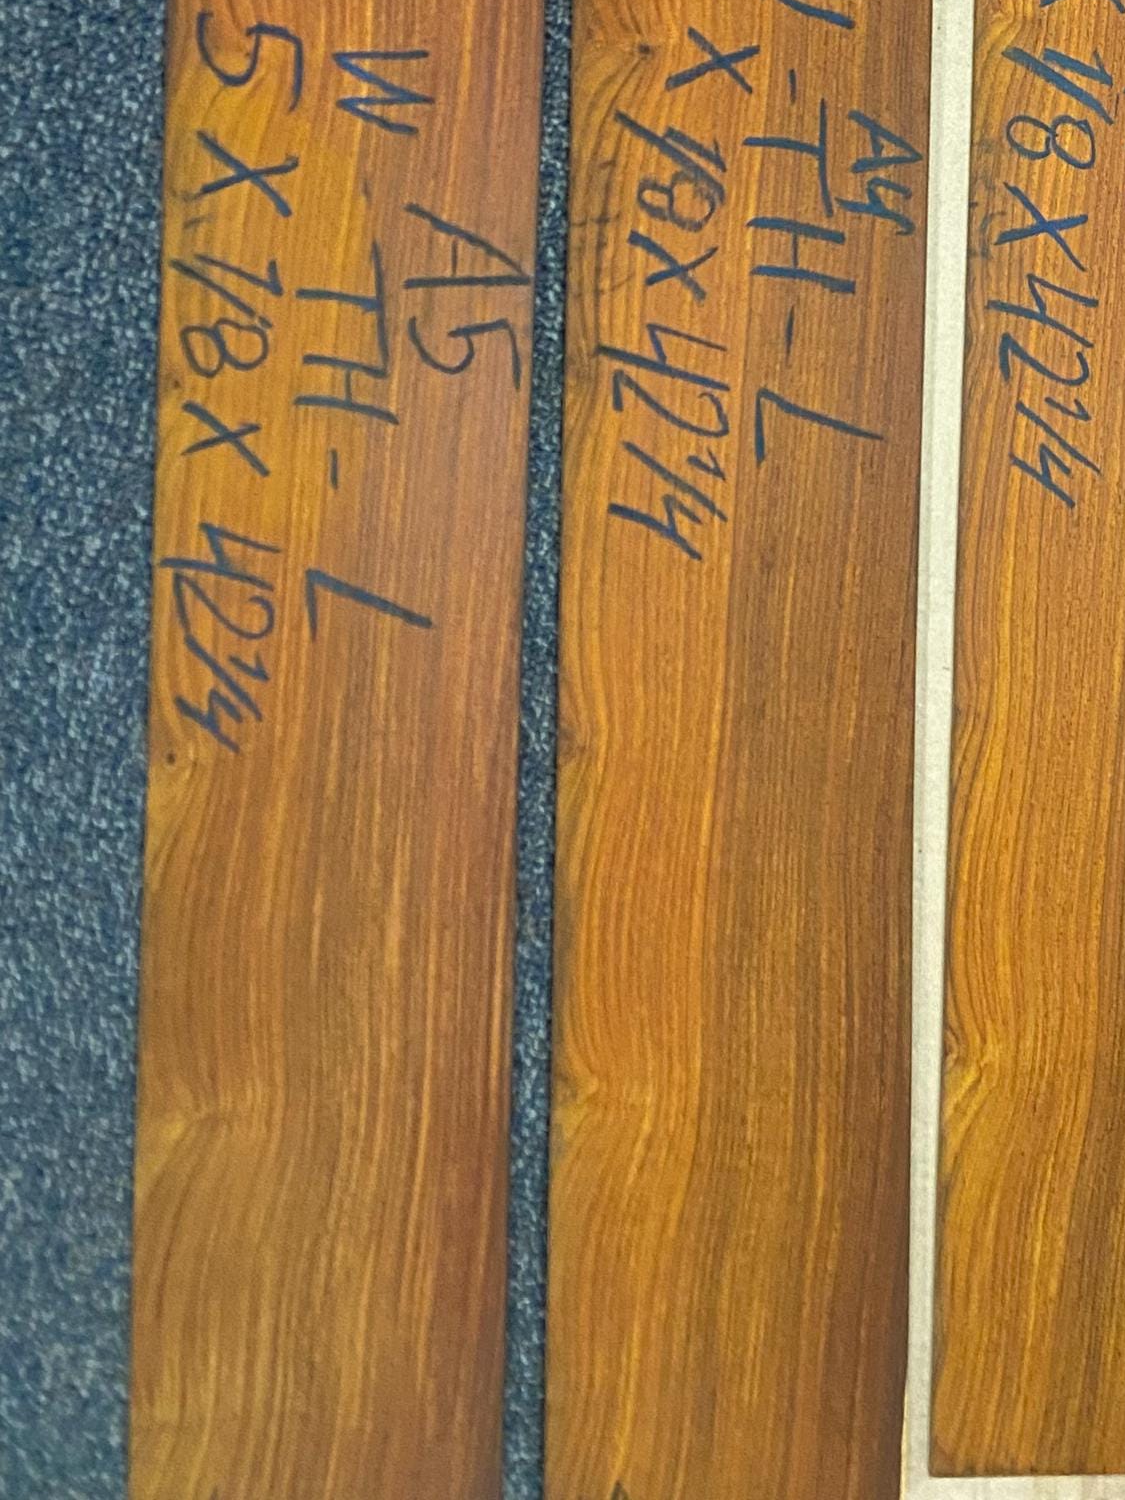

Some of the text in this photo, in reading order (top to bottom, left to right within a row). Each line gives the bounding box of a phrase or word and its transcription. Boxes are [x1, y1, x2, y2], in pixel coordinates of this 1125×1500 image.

[196, 11, 304, 113] 5
[835, 108, 925, 237] A4
[404, 202, 532, 390] A5
